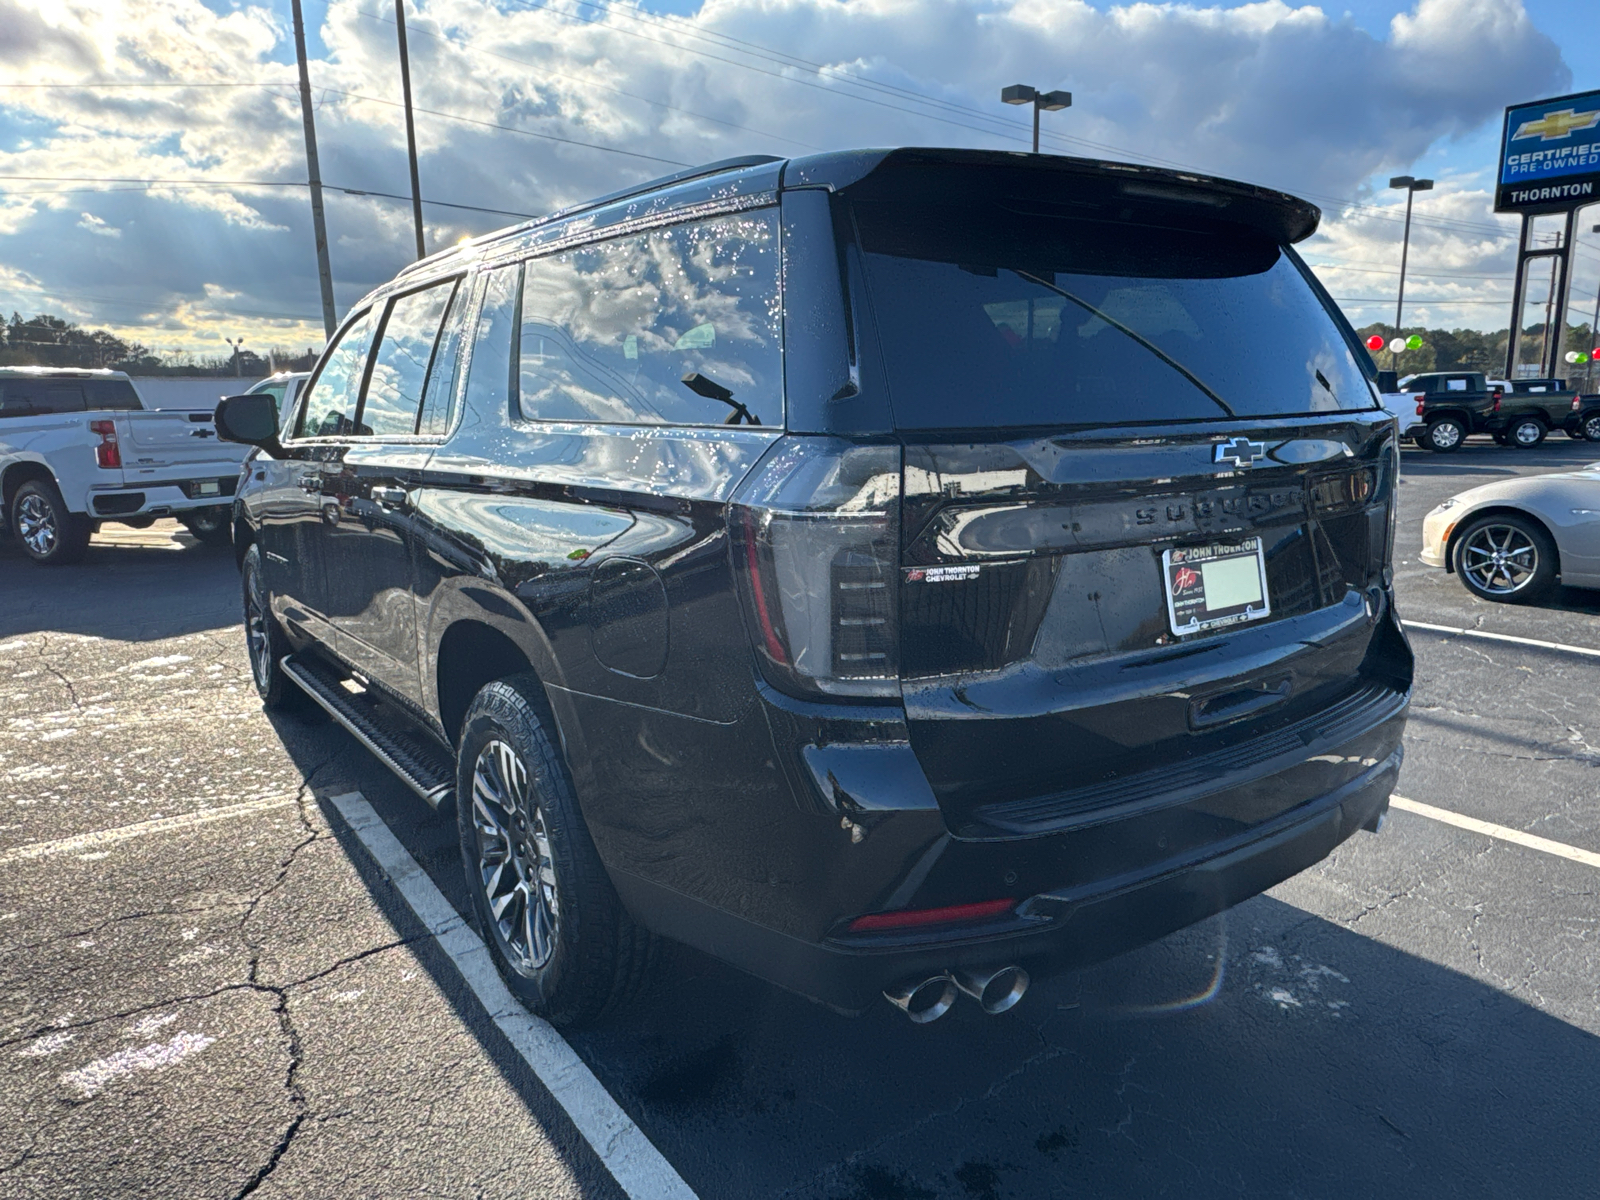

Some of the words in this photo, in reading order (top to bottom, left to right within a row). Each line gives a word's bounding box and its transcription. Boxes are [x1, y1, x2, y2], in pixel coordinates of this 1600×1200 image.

[1508, 143, 1600, 165] CERTIFIED
[1511, 154, 1598, 174] PRE-OWNED
[1511, 182, 1592, 202] THORNTON
[1187, 546, 1211, 560] JOHN
[1213, 540, 1257, 556] THORNTON
[925, 573, 967, 583] CHEVROLET
[926, 567, 943, 576] JOHN
[944, 565, 980, 575] THORNTON
